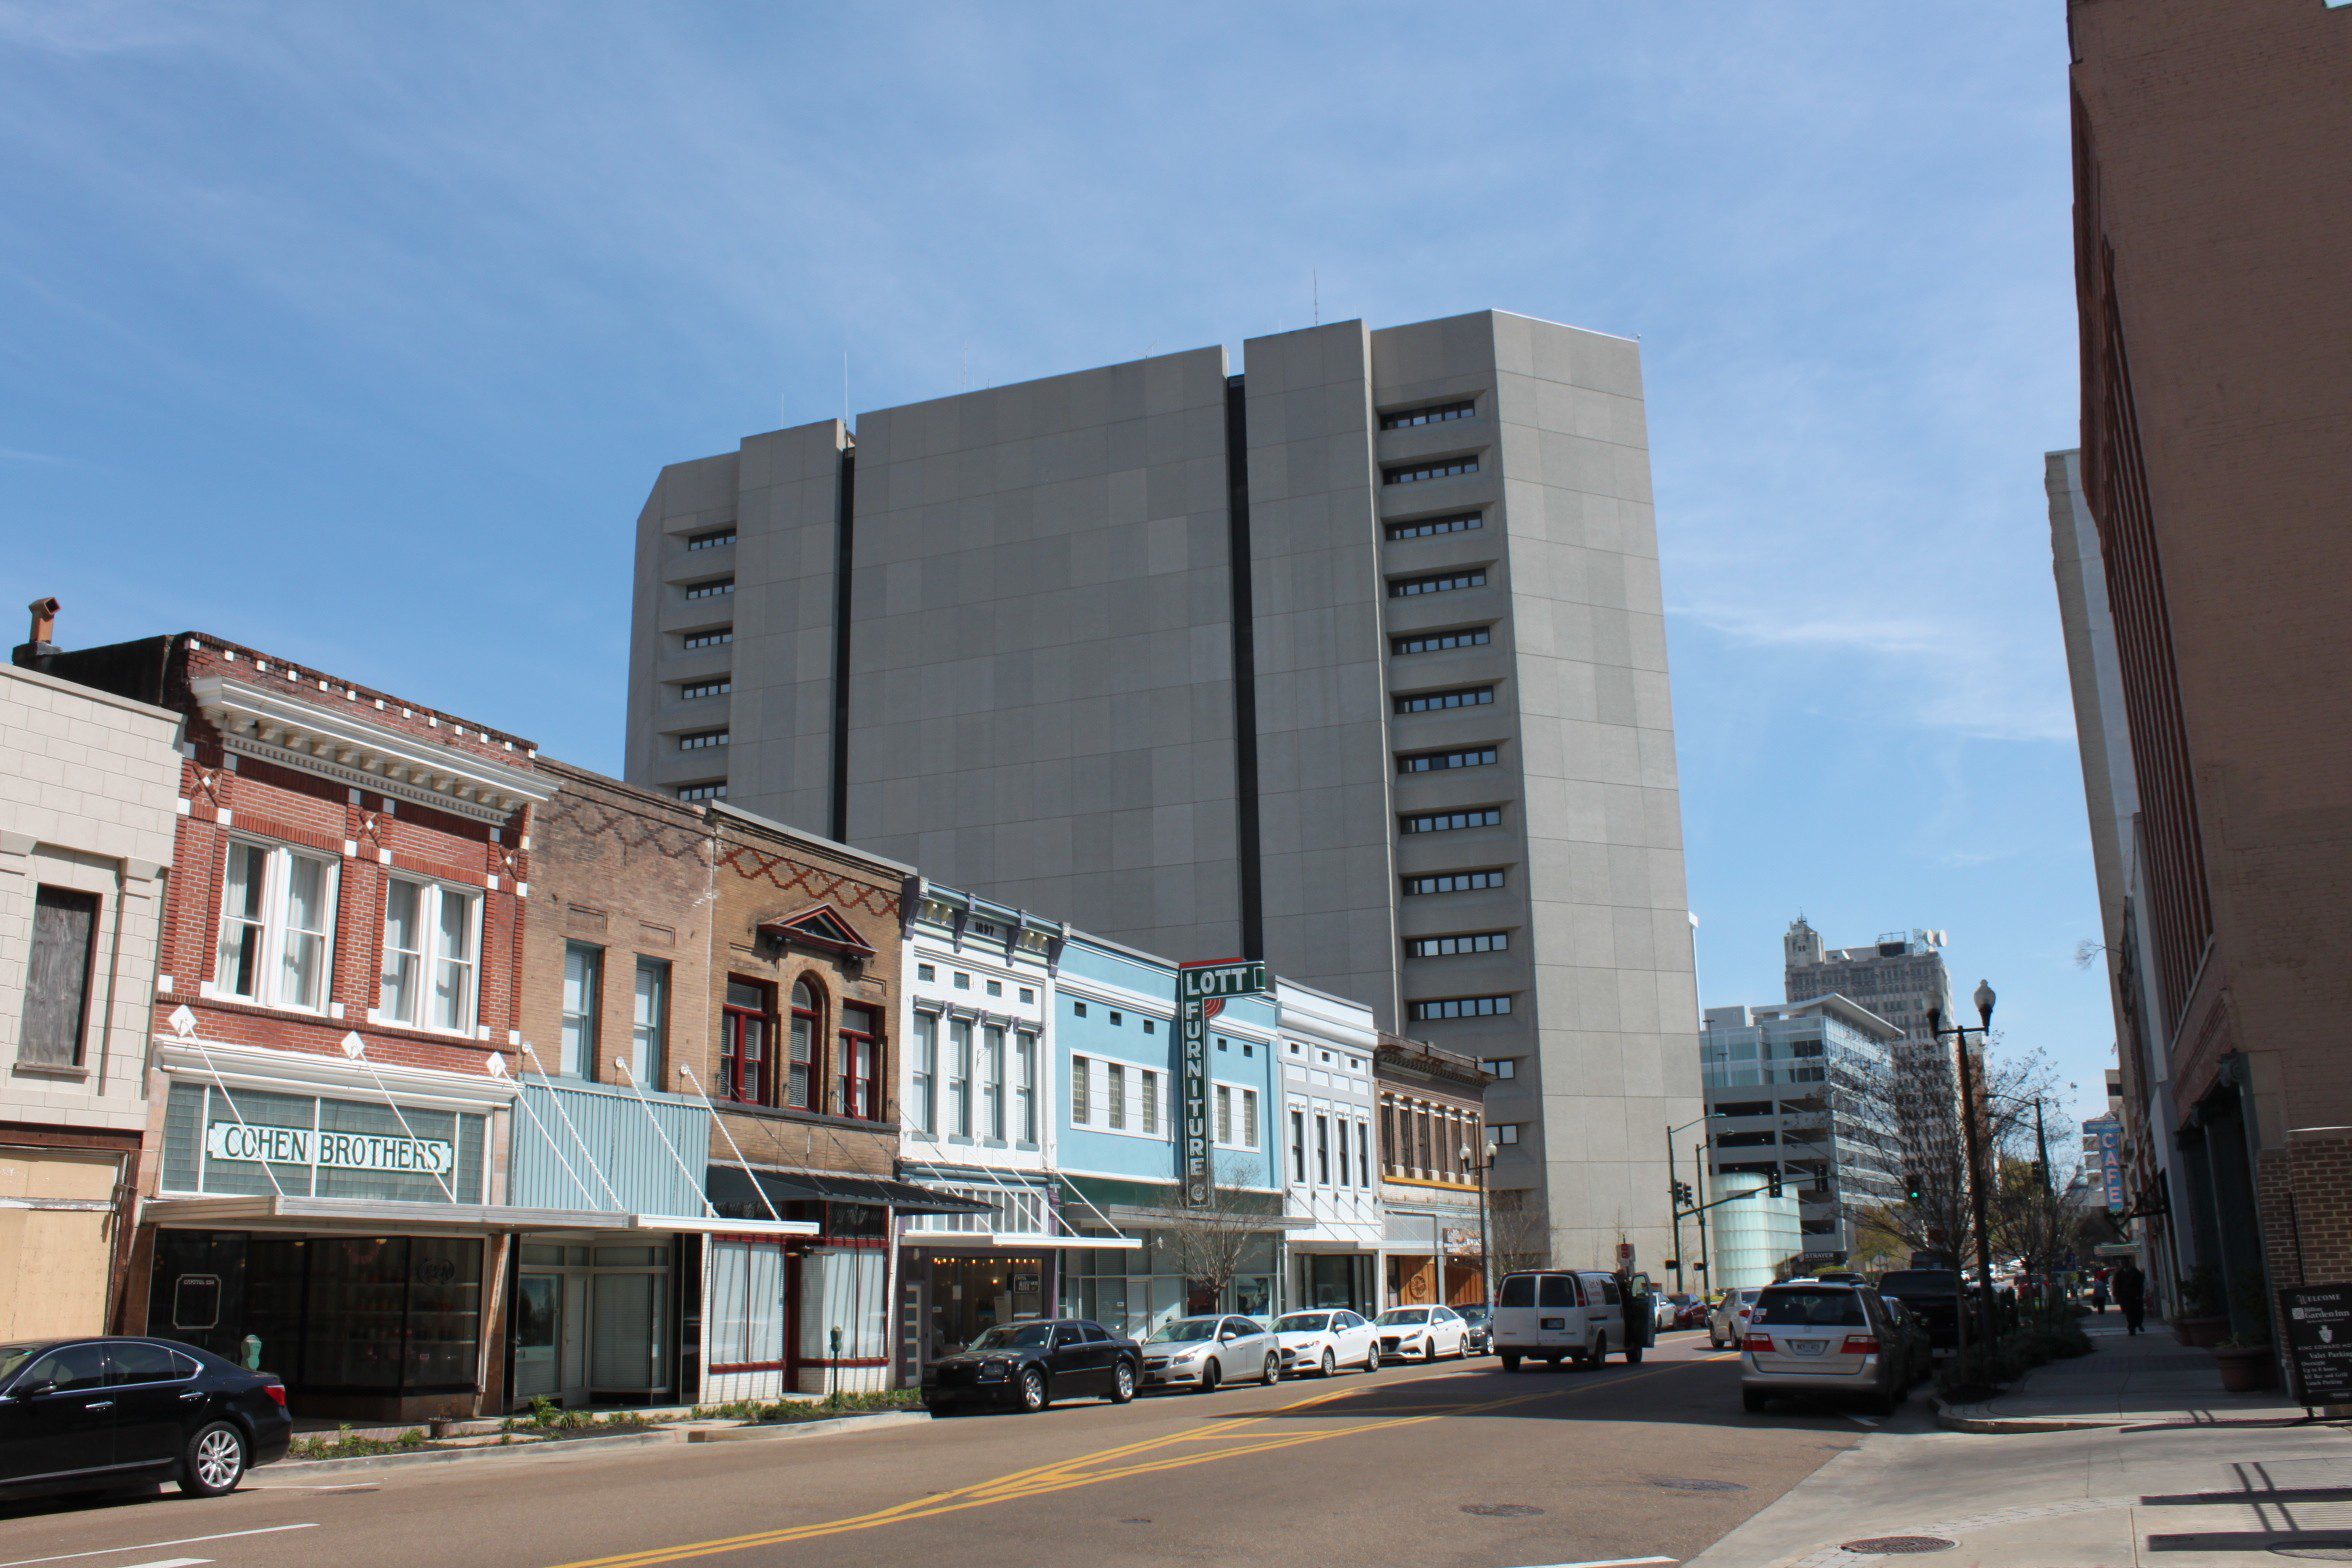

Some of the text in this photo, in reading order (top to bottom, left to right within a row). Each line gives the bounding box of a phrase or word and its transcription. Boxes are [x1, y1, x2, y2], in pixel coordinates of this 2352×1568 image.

[1186, 967, 1247, 996] LOTT
[1185, 1001, 1205, 1176] FURNITURE
[224, 1126, 441, 1170] COHEN BROTHERS
[2101, 1132, 2123, 1203] CAFE
[2296, 1293, 2341, 1305] WELCOME
